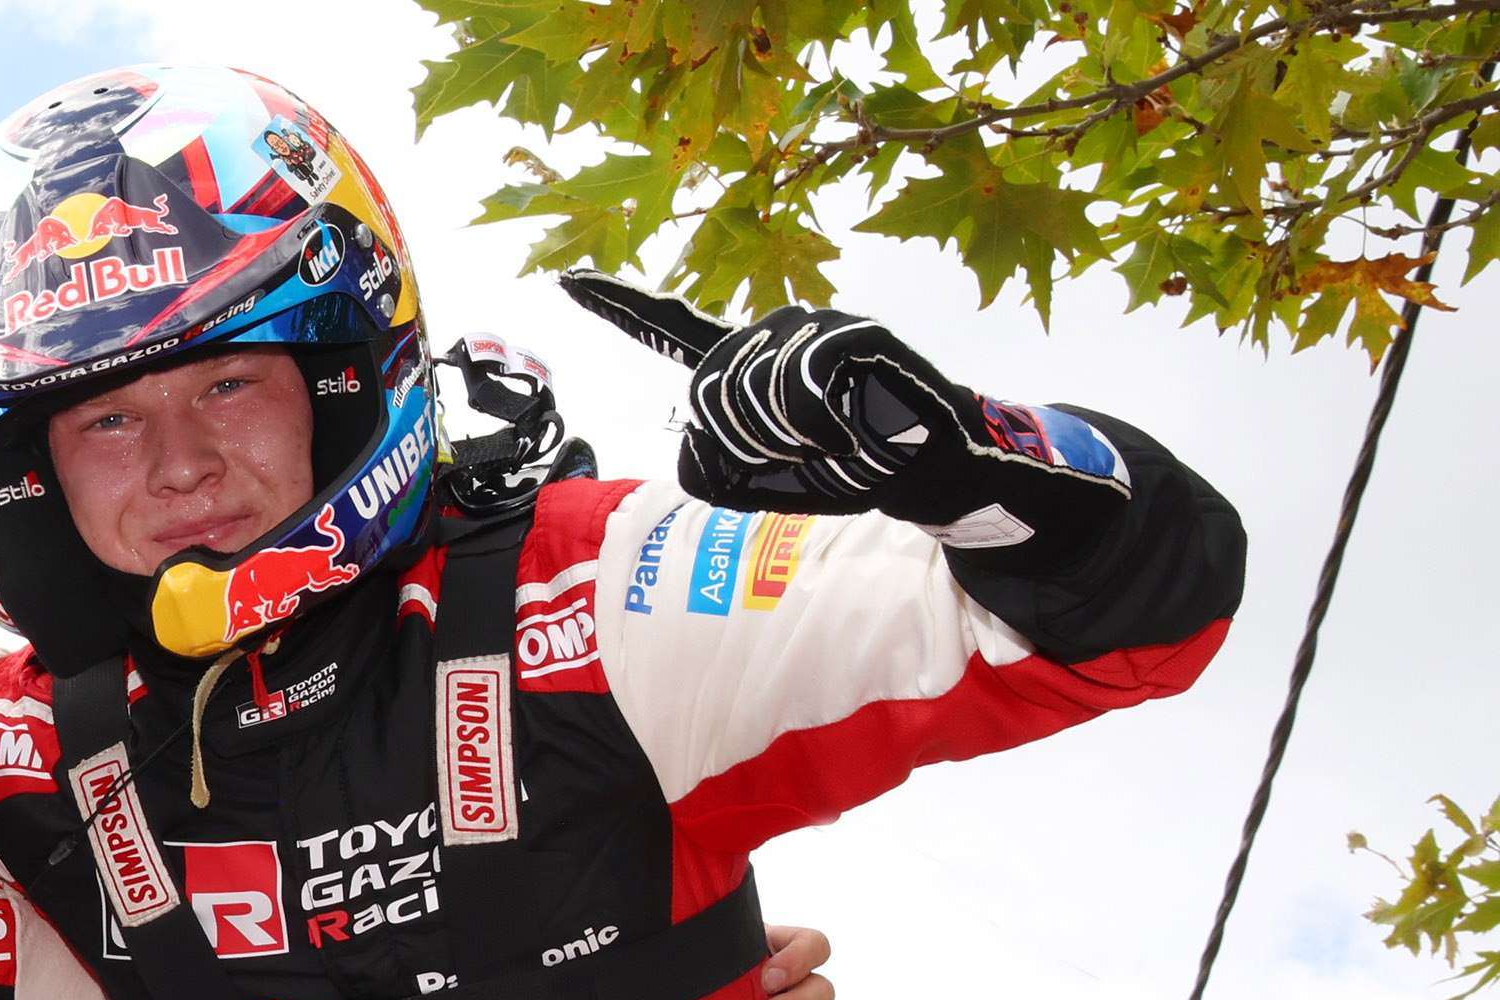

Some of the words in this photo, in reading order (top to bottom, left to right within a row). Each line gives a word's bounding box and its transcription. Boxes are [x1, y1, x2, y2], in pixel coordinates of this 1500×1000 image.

[4, 264, 94, 332] Red
[94, 246, 188, 302] Bull
[91, 337, 180, 373] GAZOO
[184, 295, 256, 341] Racing
[348, 399, 436, 520] UNIBET
[518, 611, 595, 666] OMP
[286, 661, 339, 695] TOYOTA
[288, 674, 336, 704] GAZOO
[289, 684, 336, 712] Racing
[456, 681, 495, 824] SIMPSON
[89, 773, 158, 905] SIMPSON
